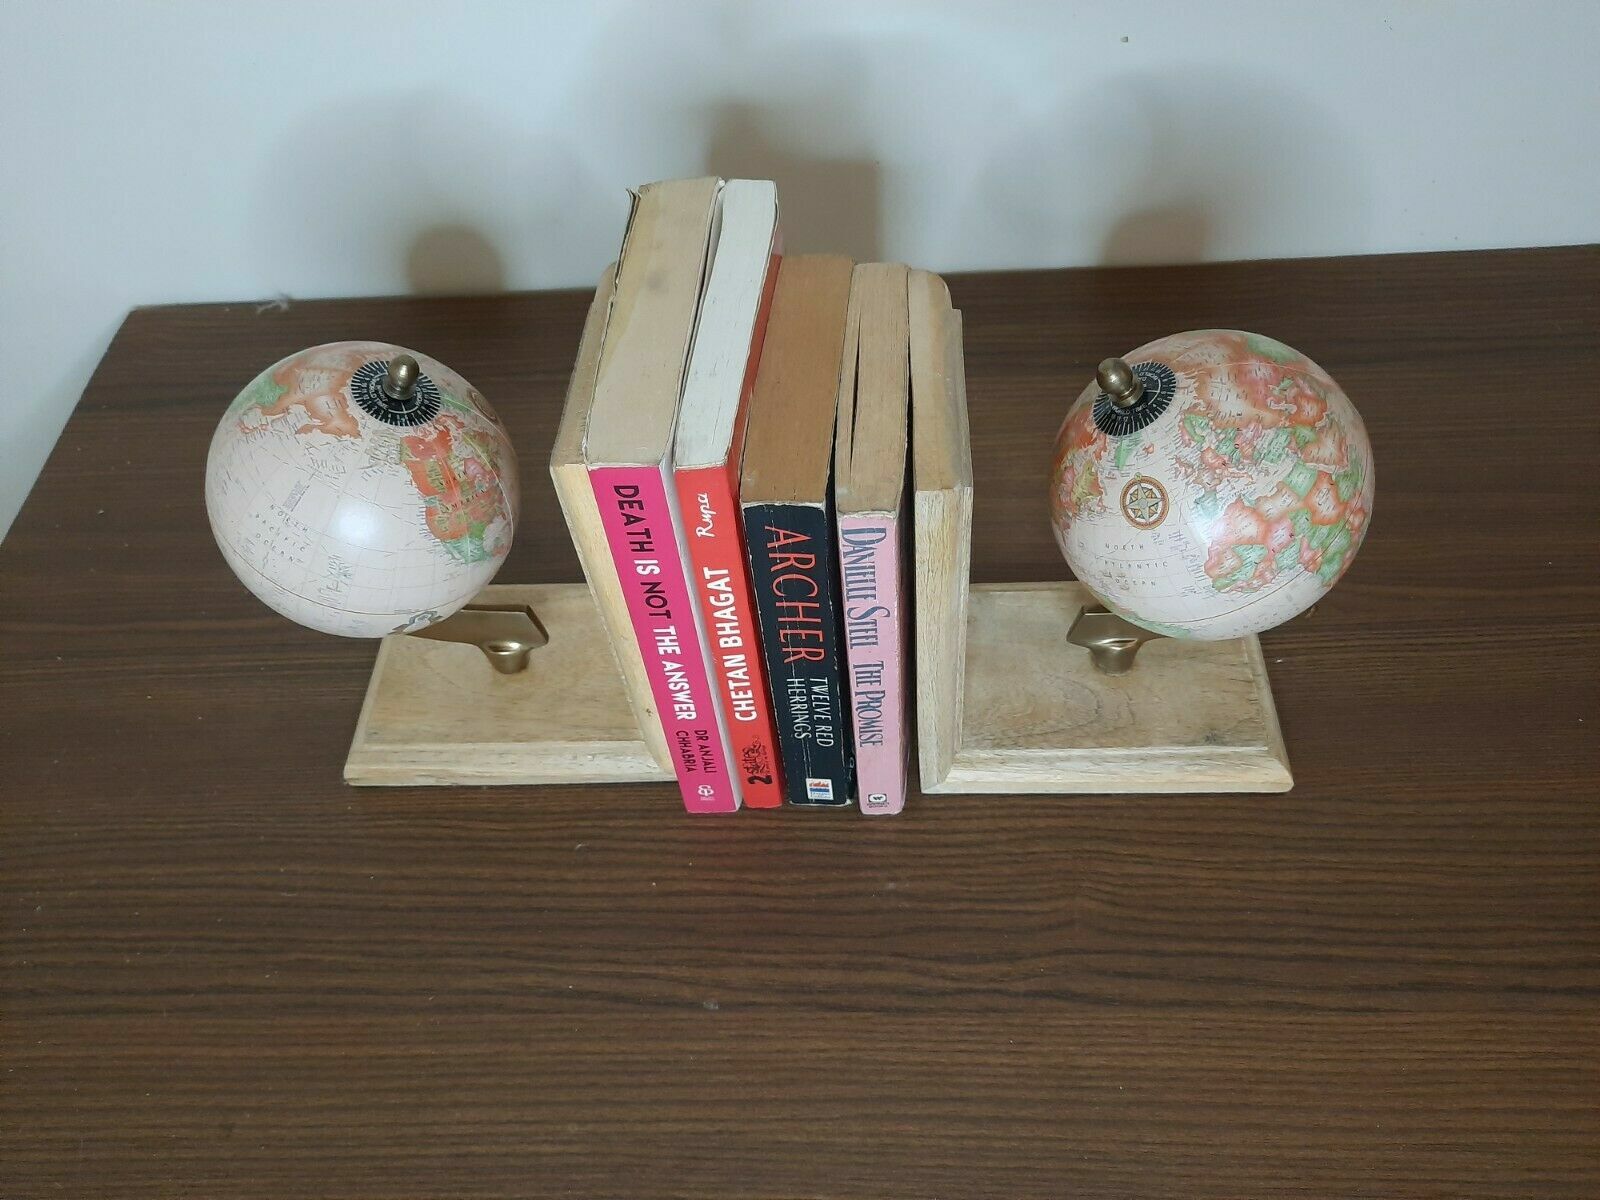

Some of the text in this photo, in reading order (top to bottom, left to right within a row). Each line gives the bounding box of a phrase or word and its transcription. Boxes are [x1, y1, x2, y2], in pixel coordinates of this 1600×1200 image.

[613, 484, 697, 722] DEATH IS NOT THE ANSWER
[703, 566, 757, 721] CHETAN BHAGAT
[764, 525, 828, 664] ARCHER
[841, 527, 891, 748] DANIELLE STEEL THE PROMISE
[676, 730, 697, 773] CHHABRIA
[694, 729, 718, 774] DR ANJALI
[786, 678, 812, 740] HERRINGS
[809, 676, 834, 748] TWELVE RED
